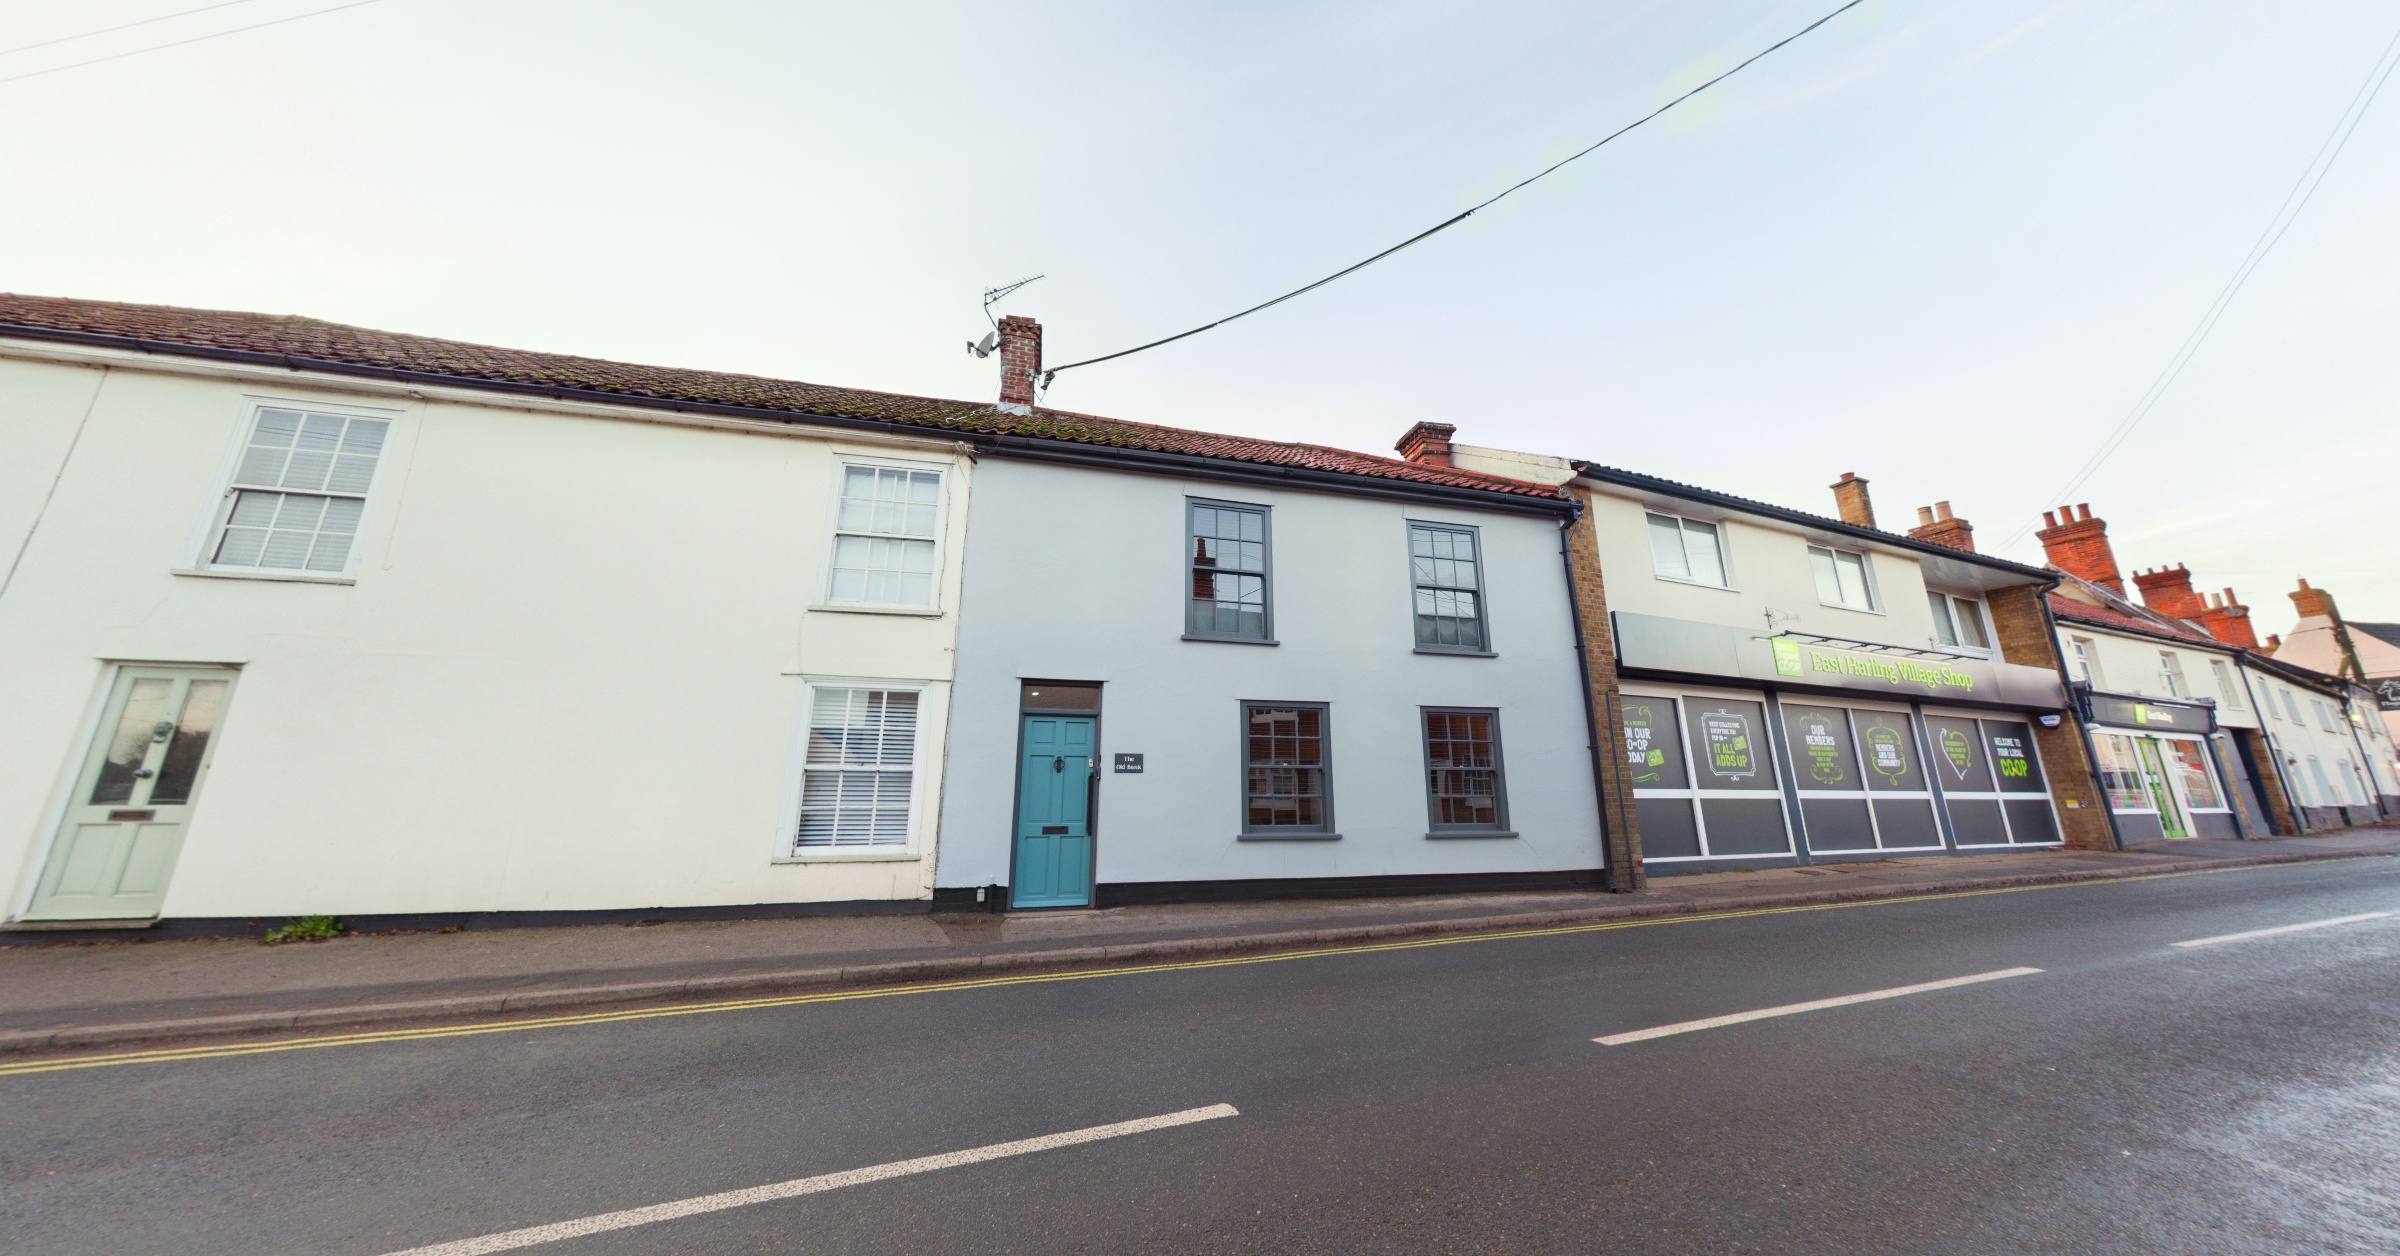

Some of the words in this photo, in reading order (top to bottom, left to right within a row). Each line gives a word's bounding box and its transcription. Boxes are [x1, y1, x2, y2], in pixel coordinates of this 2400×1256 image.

[1809, 651, 1844, 674] East
[1844, 655, 1899, 685] Harling
[1896, 661, 1941, 688] Village
[1941, 667, 1973, 692] Shop
[1634, 728, 1651, 739] OUR
[1810, 724, 1826, 735] OUR
[1627, 739, 1648, 750] O-OP
[1805, 735, 1835, 746] MEMBERS
[1713, 743, 1721, 754] IT
[1722, 743, 1736, 755] ALL
[1716, 754, 1737, 767] ADDS
[1736, 755, 1748, 767] UP
